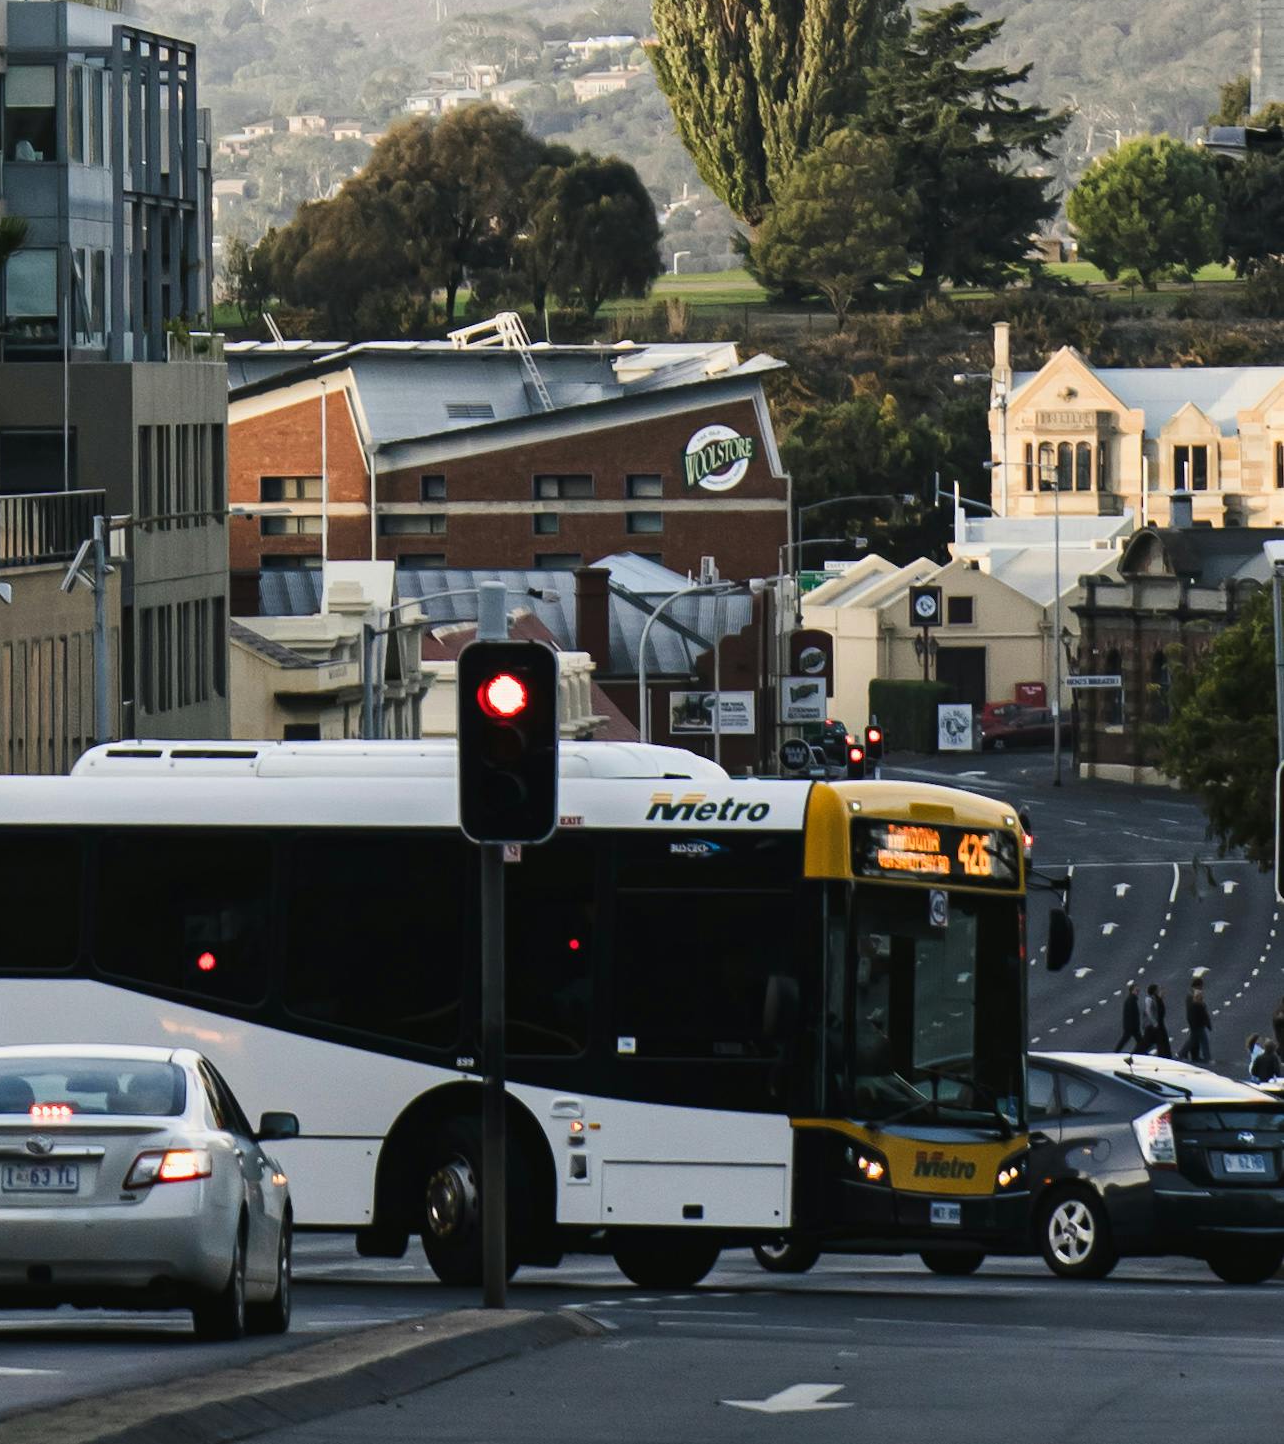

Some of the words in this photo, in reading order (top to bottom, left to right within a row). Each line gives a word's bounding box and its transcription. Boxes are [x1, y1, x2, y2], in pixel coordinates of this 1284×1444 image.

[685, 437, 753, 487] WOOLSTORE
[645, 793, 771, 822] Metro
[958, 833, 993, 875] 426
[914, 1151, 977, 1180] Metro
